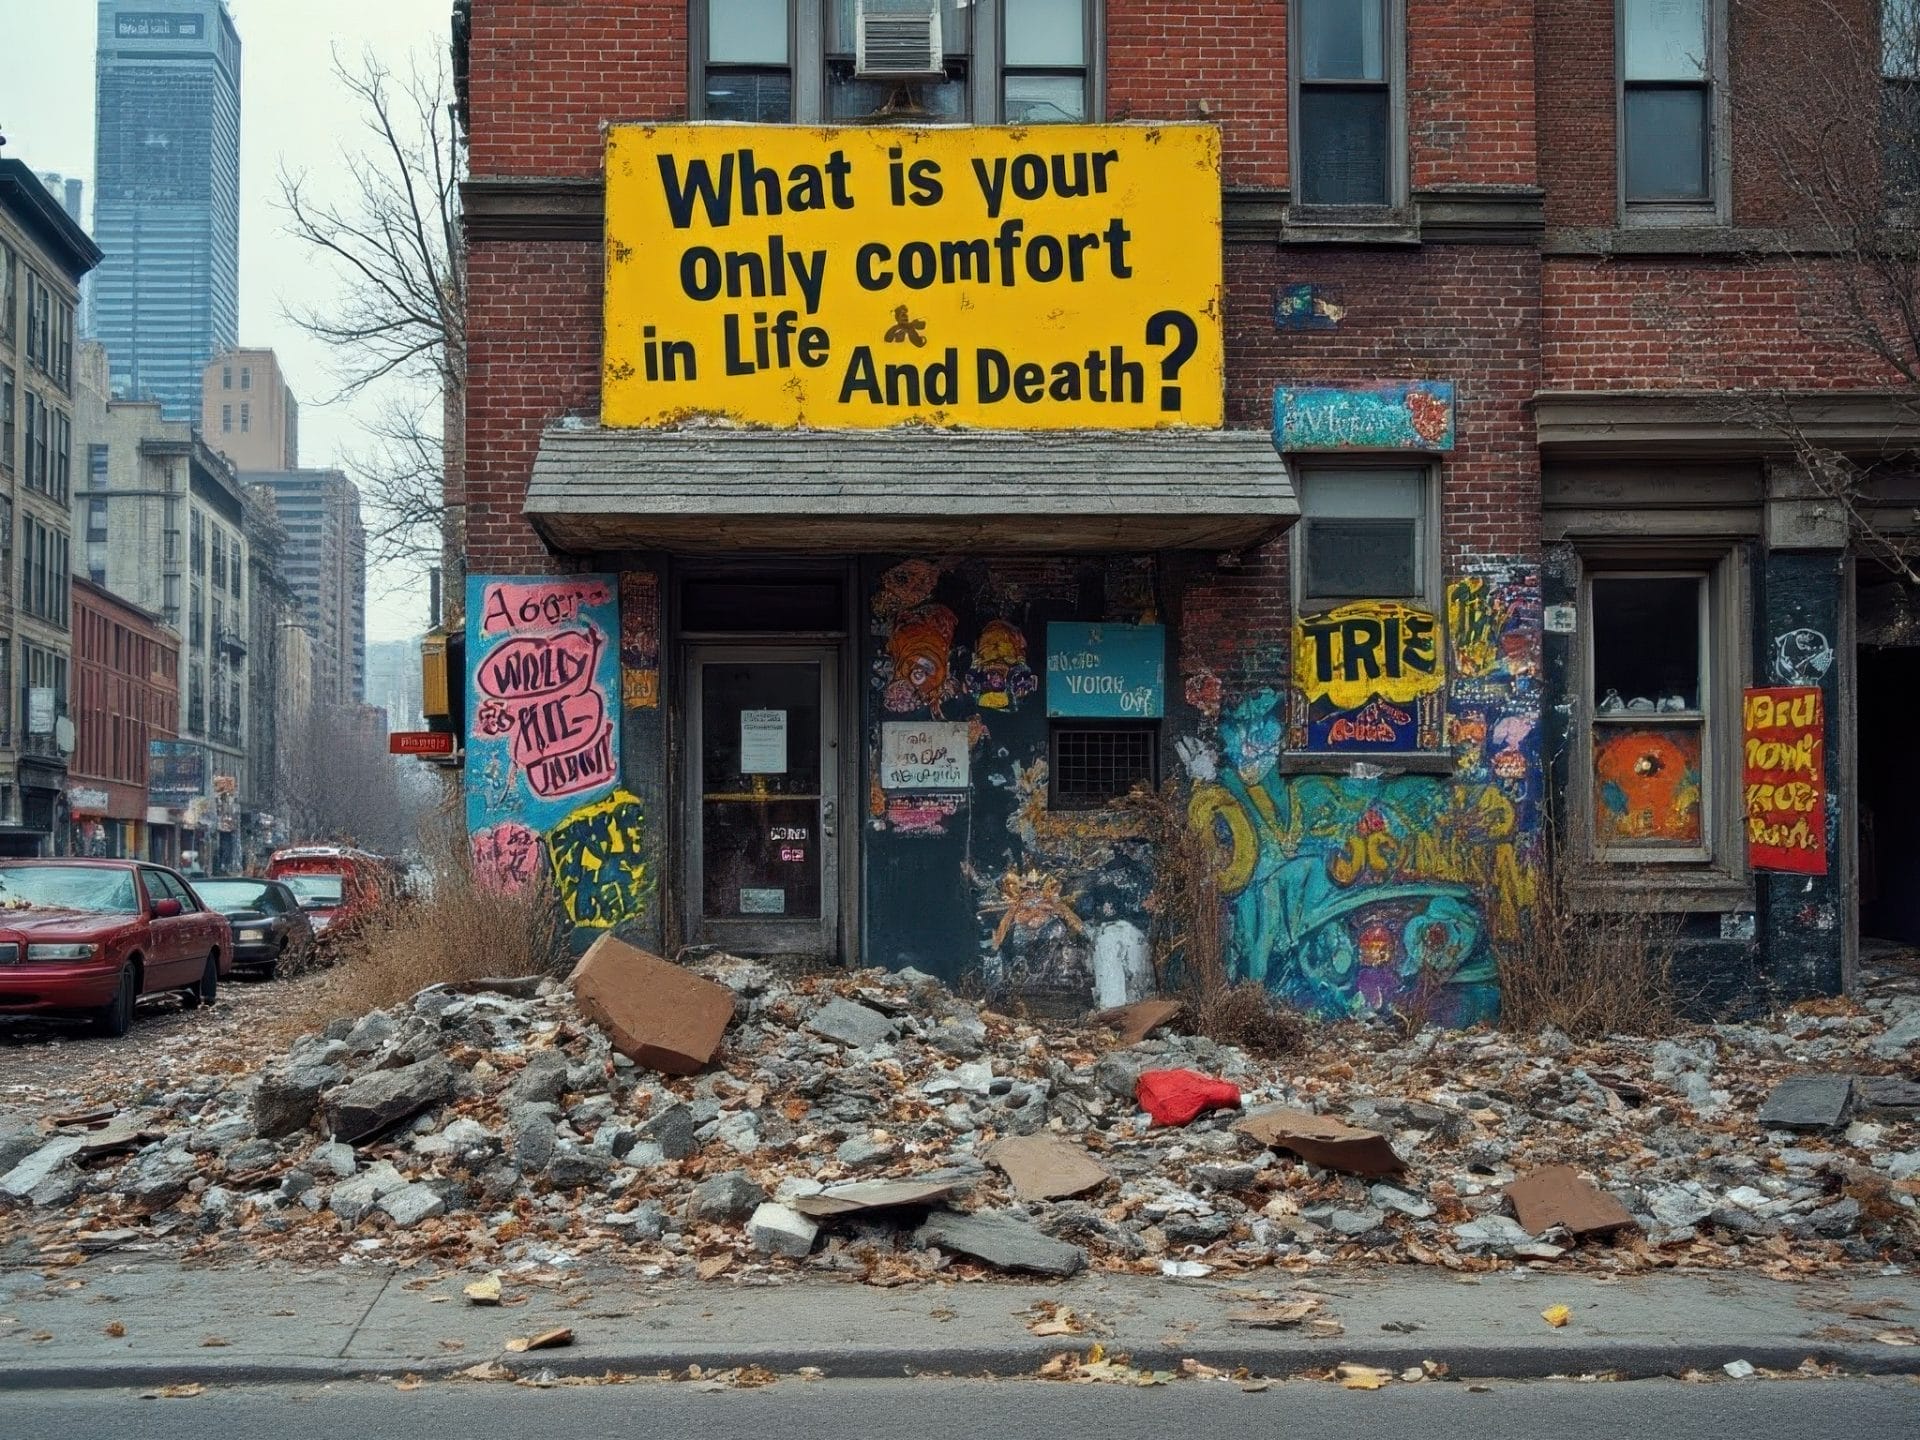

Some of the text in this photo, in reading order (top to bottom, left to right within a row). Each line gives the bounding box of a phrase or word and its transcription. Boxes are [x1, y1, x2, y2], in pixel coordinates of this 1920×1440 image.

[657, 147, 1119, 229] What is your
[856, 218, 1133, 291] comfort
[643, 309, 1198, 412] in Life And Death?
